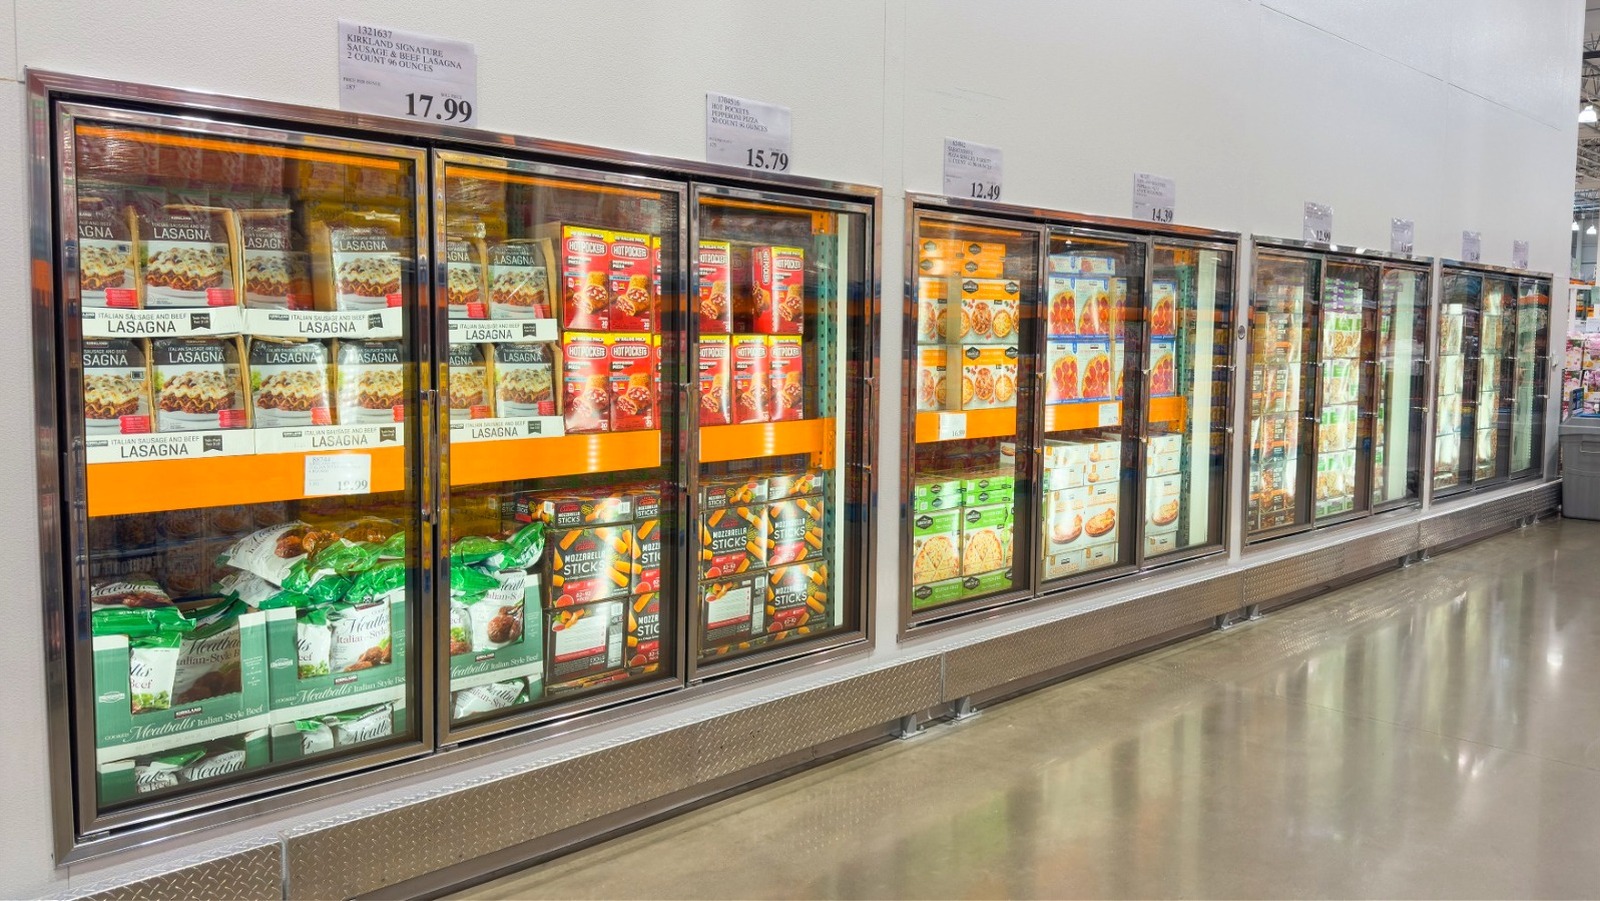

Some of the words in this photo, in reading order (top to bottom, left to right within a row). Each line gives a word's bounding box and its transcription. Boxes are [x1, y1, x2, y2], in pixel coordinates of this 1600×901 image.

[357, 26, 392, 38] 1321637
[347, 34, 393, 48] KIRKLAND
[396, 41, 444, 57] SIGNATURE
[347, 43, 388, 56] SAUSAGE
[400, 52, 420, 62] BEEF
[423, 56, 462, 69] LASAGNA
[354, 53, 385, 65] COUNT
[388, 58, 397, 66] 96
[399, 60, 433, 72] OUNCES
[405, 93, 472, 123] 17.99
[725, 106, 749, 115] POCKETS
[712, 110, 741, 120] PEPPERONI
[742, 115, 758, 123] PIZZA
[719, 118, 738, 126] COUNT
[746, 123, 768, 132] OUNCES
[746, 149, 788, 171] 15.79
[971, 182, 1000, 200] 12.49
[1152, 208, 1173, 222] 14.39
[79, 226, 113, 238] AGNA
[154, 228, 212, 240] LASAGNA
[340, 240, 387, 250] LASAGNA
[569, 241, 580, 251] HOT
[448, 252, 470, 261] AGNA
[614, 246, 624, 255] HOT
[625, 246, 646, 257] POCKETS
[497, 256, 535, 265] LASAGNA
[700, 254, 709, 263] OT
[108, 321, 176, 333] LASAGNA
[299, 322, 356, 332] LASAGNA
[466, 330, 512, 340] LASAGNA
[169, 352, 225, 363] LASAGNA
[266, 353, 317, 363] LASAGNA
[358, 353, 398, 363] ASAGNA
[504, 353, 542, 362] LASAGNA
[614, 347, 624, 356] HOT
[625, 347, 647, 357] POCKETS
[84, 354, 128, 365] SAGNA
[449, 356, 473, 365] AGNA
[472, 427, 518, 438] LASAGNA
[312, 435, 368, 448] LASAGNA
[121, 444, 188, 458] LASAGNA
[712, 527, 747, 538] MOZZARELLA
[774, 526, 805, 539] STICKS
[712, 536, 747, 550] STICKS
[565, 550, 606, 563] MOZZARELLA
[564, 562, 606, 575] STICKS
[775, 592, 807, 606] STICKS
[638, 623, 659, 636] STIC
[452, 662, 490, 678] eatballs
[291, 685, 353, 706] Meatballs
[354, 683, 375, 693] Italian
[377, 680, 394, 688] Style
[123, 717, 196, 742] Meatballs
[197, 715, 223, 727] Italian
[225, 712, 244, 723] Style
[246, 705, 263, 717] Beef
